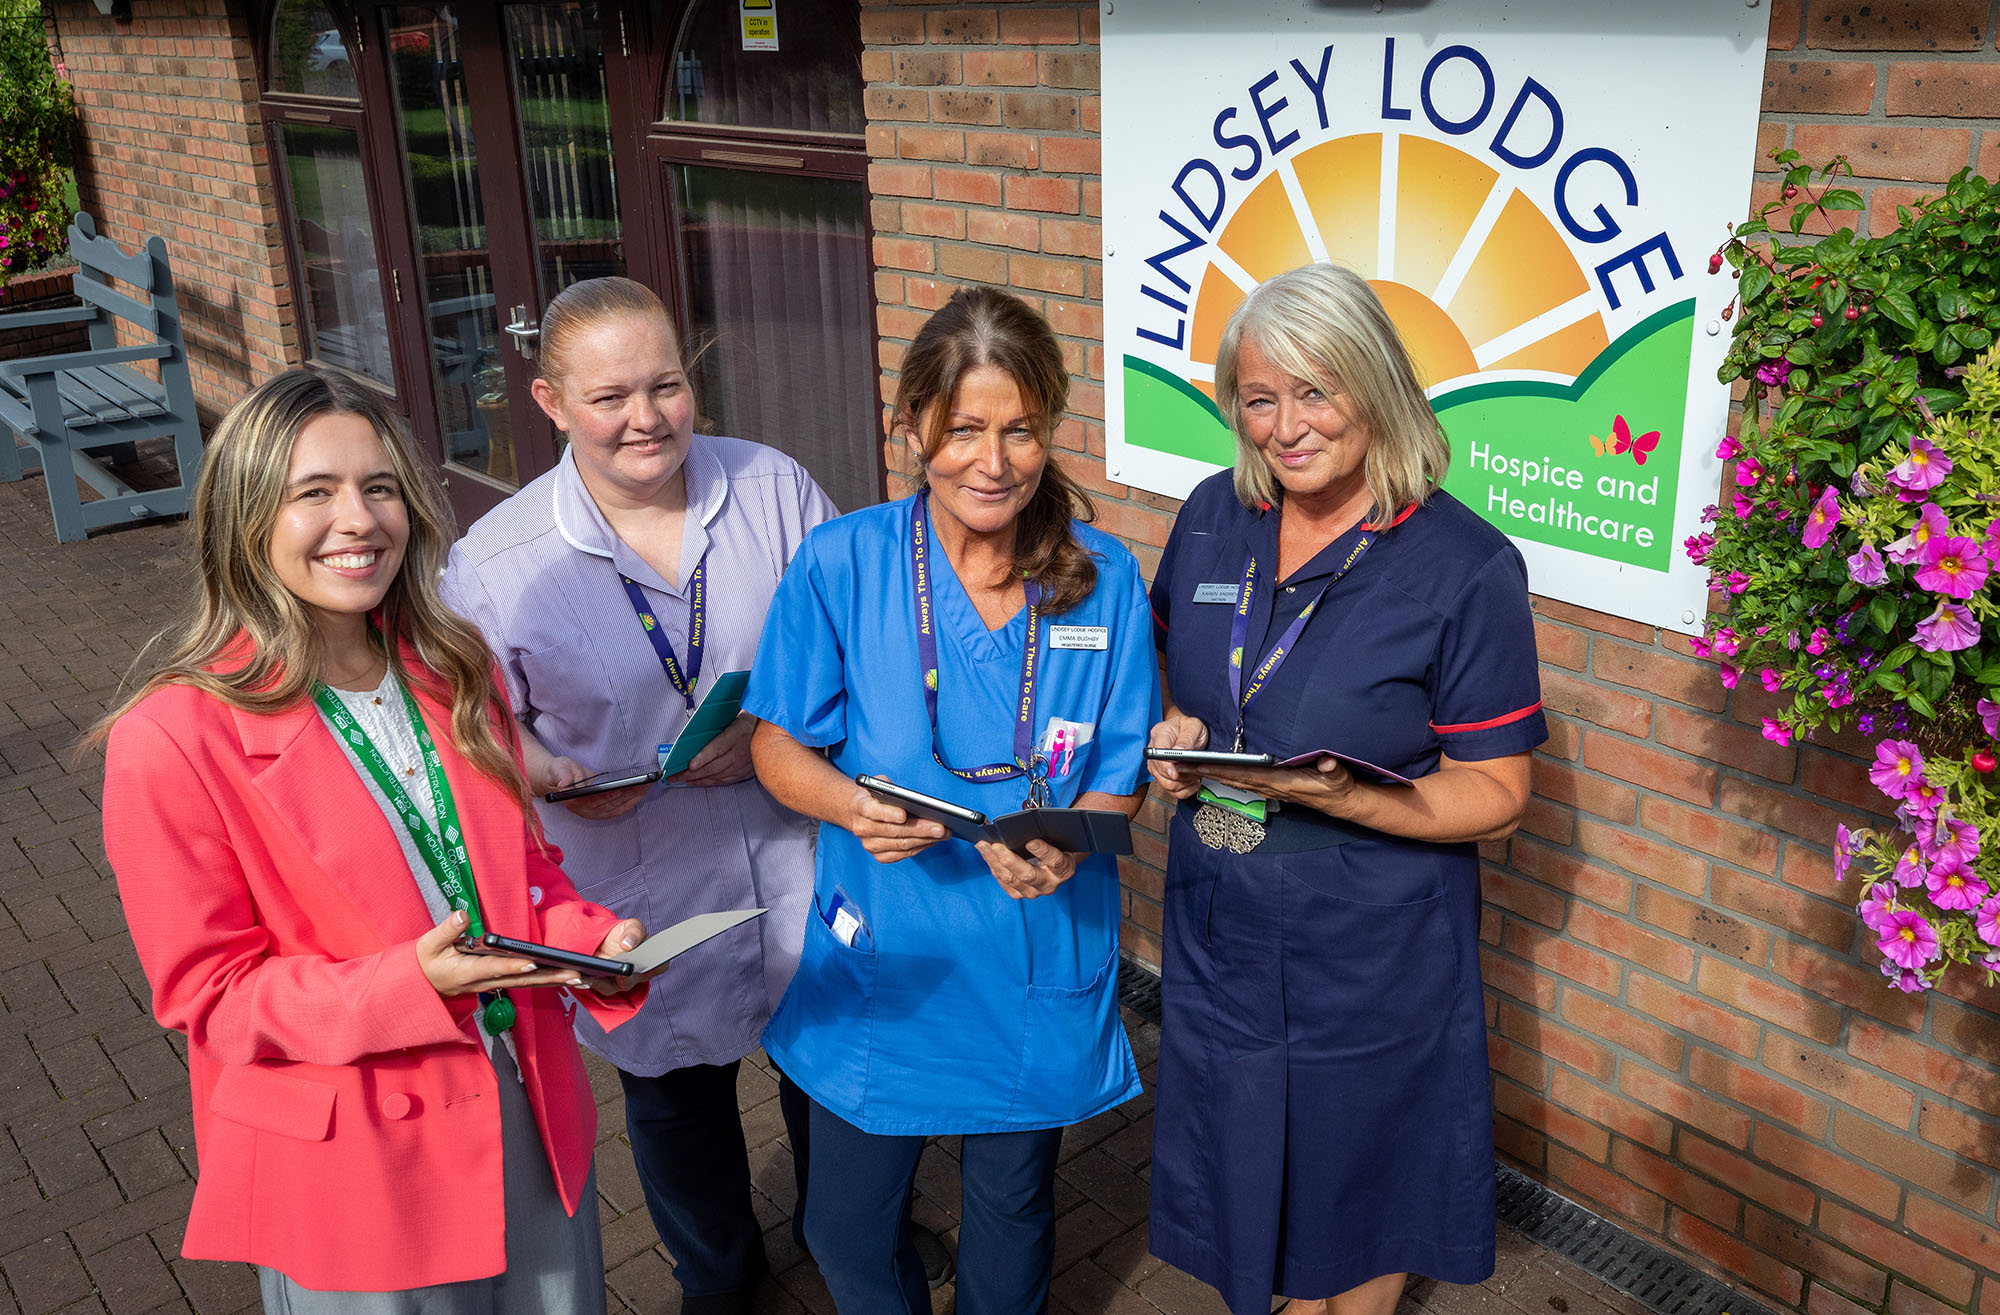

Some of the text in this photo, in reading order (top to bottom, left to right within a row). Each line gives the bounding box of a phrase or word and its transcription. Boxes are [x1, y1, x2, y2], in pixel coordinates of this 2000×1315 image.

[1136, 37, 1684, 349] LINDSEY LODGE
[1470, 440, 1659, 506] Hospice and
[1487, 484, 1655, 548] Healthcare
[1344, 537, 1368, 570] Always
[694, 569, 702, 580] To
[914, 520, 930, 635] Always There To Care
[1239, 556, 1256, 616] Always Ther
[694, 582, 702, 610] There
[692, 612, 702, 647] Always
[664, 658, 683, 690] Always
[1020, 605, 1038, 722] Always There To Care
[1258, 646, 1285, 681] Always
[332, 712, 348, 730] ESH
[430, 750, 442, 768] ESH
[974, 766, 1012, 778] Always
[369, 749, 412, 810] CONSTRUCTION
[424, 752, 446, 819] CONSTRUCTION
[394, 796, 407, 814] ESH
[424, 832, 462, 894] CONSTRUCTION
[456, 846, 466, 864] ESH
[441, 880, 455, 898] ESH
